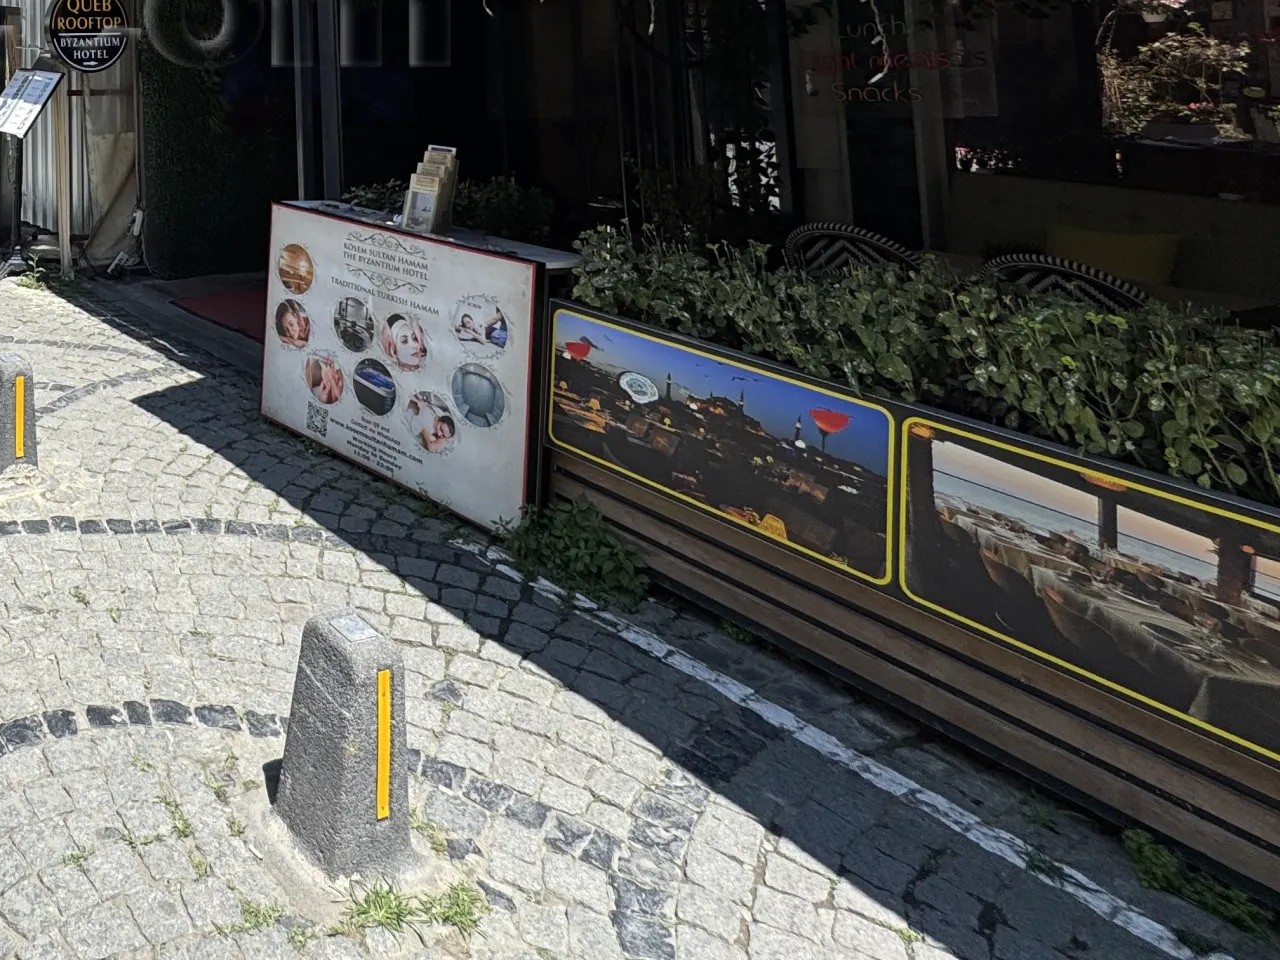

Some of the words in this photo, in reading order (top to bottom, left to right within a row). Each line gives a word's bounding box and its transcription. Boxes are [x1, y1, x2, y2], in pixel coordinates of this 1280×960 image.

[57, 16, 122, 30] ROOFTOP
[60, 37, 121, 47] BYZANTIUM
[73, 49, 109, 59] HOTEL
[831, 80, 923, 103] Snacks
[342, 251, 357, 262] THE
[358, 254, 401, 273] BYZANTIUM
[402, 266, 430, 281] HOTEL
[368, 248, 396, 262] SULTAN
[398, 255, 429, 271] HAMAM
[330, 276, 376, 296] TRADITIONAL
[377, 290, 408, 307] TURKISH
[410, 300, 440, 316] HAMAM
[346, 439, 370, 455] Monday
[378, 455, 403, 471] Sunday
[352, 435, 378, 452] Working
[378, 446, 398, 461] Hours
